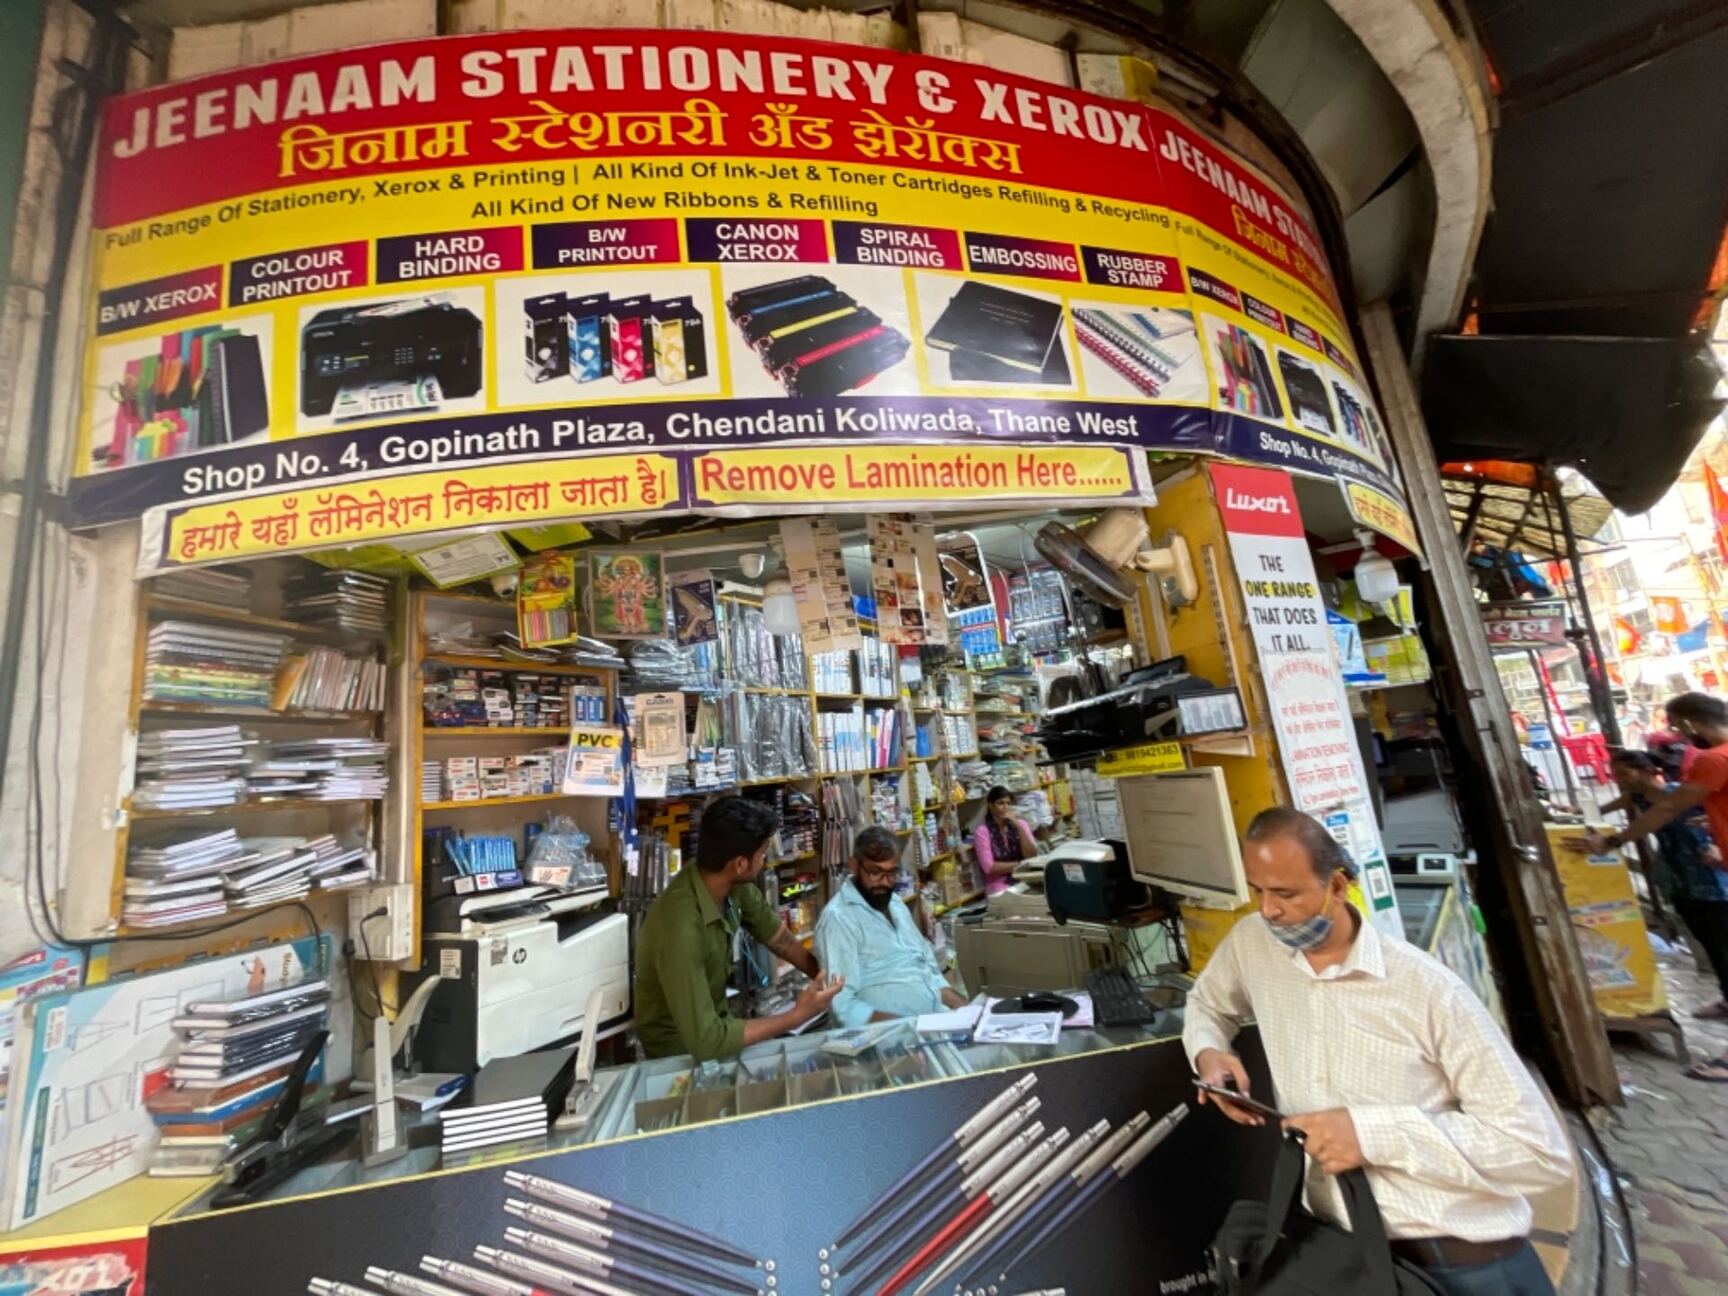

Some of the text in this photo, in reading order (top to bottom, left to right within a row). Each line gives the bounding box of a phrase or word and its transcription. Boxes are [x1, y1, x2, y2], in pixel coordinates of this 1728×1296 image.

[113, 45, 1150, 159] JEENAAM STATIONERY & XEROX
[278, 98, 1024, 177] जिनाम स्टेशनरी अँड झेरॉक्स
[1160, 130, 1273, 225] JEENAAM
[105, 166, 566, 250] Full Range Of Stationery, Xerox & Printing
[471, 192, 879, 219] All Kind Of New Ribbons & Refilling
[593, 161, 1170, 229] All Kind Of Ink-Jet & Toner Cartridges Refilling & Recycling
[588, 227, 627, 243] B/W
[716, 224, 799, 241] CANON
[860, 227, 937, 249] SPIRAL
[416, 236, 484, 258] HARD
[558, 245, 657, 262] PRINTOUT
[717, 243, 799, 261] XEROX
[857, 245, 945, 268] BINDING
[969, 244, 1077, 273] EMBOSSING
[251, 250, 344, 278] COLOUR
[399, 253, 501, 279] BINDING
[1098, 253, 1168, 275] RUBBER
[243, 270, 352, 302] PRINTOUT
[1107, 268, 1164, 288] STAMP
[101, 282, 217, 323] B/W XEROX
[183, 407, 1138, 495] Shop No. 4, Gopinath Plaza, Chendani Koliwada, Thane West
[1259, 431, 1291, 458] Shop
[700, 457, 836, 494] Remove
[846, 453, 1012, 489] Lamination
[1226, 488, 1291, 514] Luxor
[182, 511, 241, 559] हमारे
[252, 501, 299, 546] यहाँ
[309, 490, 433, 537] लॅमिनेशन
[443, 480, 550, 516] निकाला
[561, 474, 629, 507] जाता
[1259, 555, 1284, 572] THE
[1245, 582, 1313, 599] ONE RANGE
[1253, 608, 1317, 625] THAT DOES
[1272, 635, 1311, 651] IT ALL.
[577, 733, 613, 748] PVC
